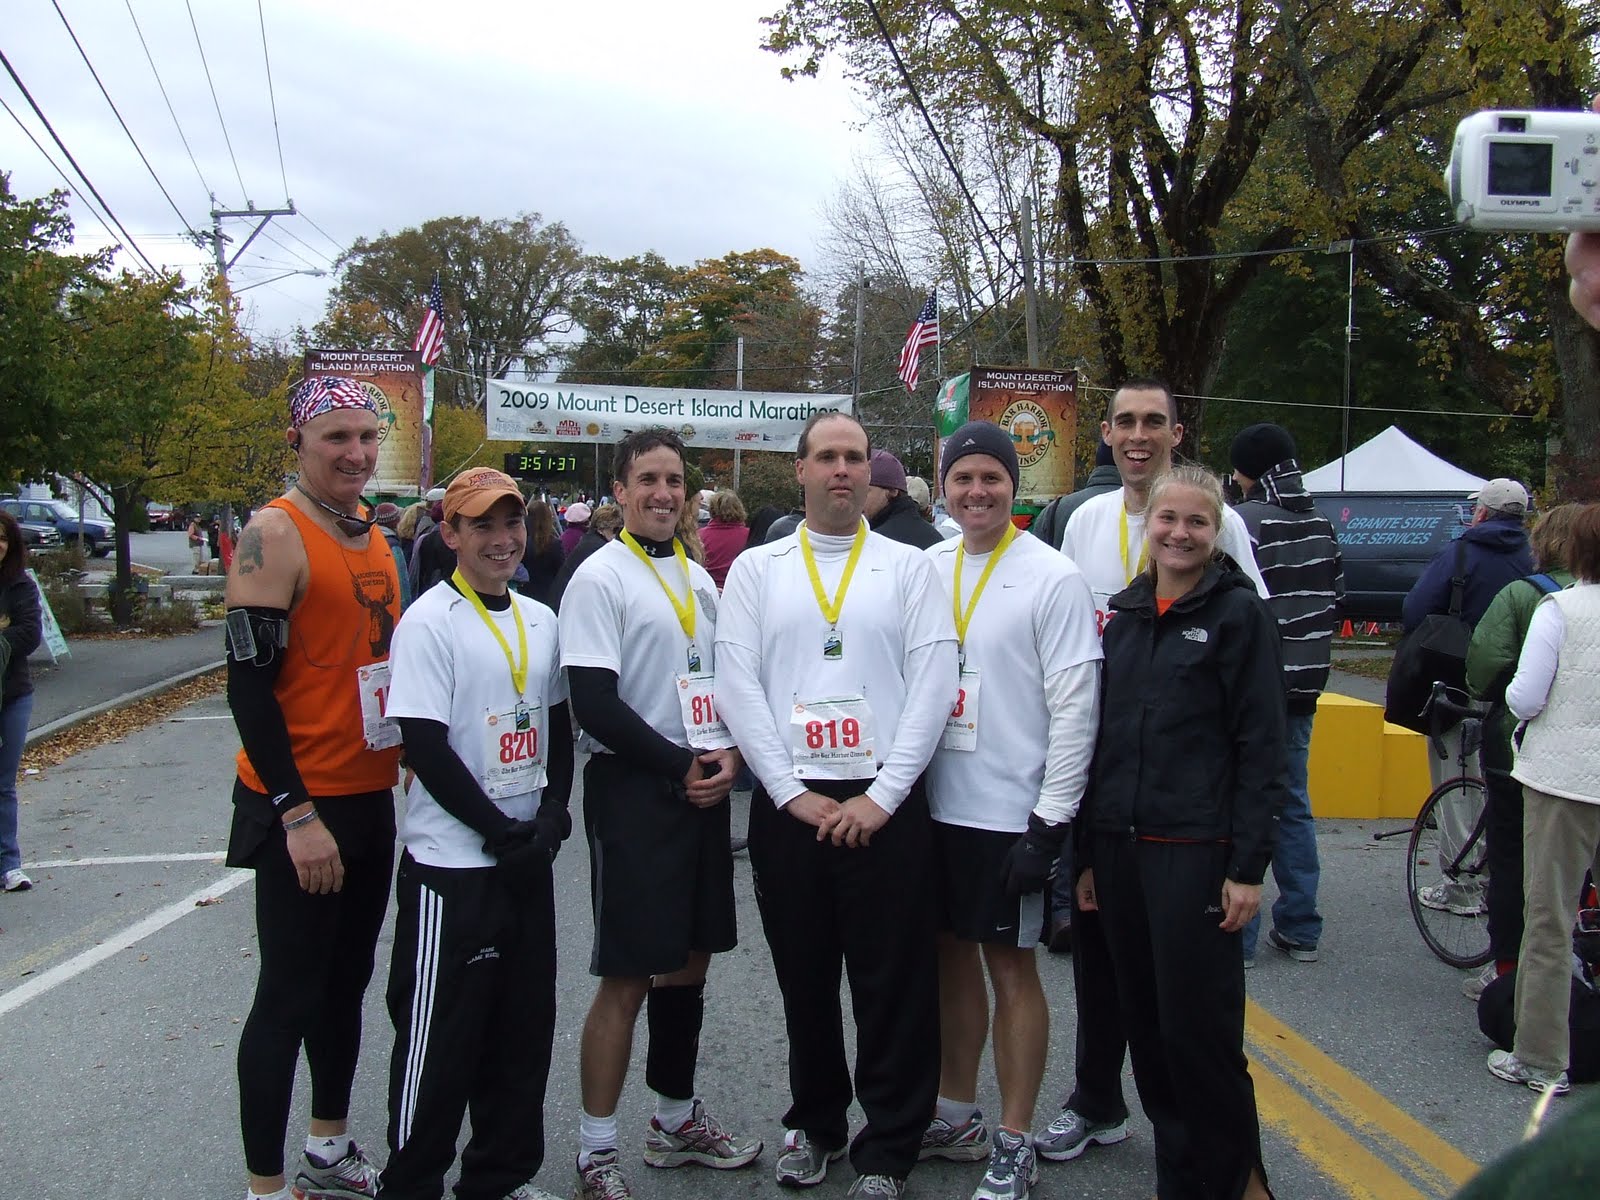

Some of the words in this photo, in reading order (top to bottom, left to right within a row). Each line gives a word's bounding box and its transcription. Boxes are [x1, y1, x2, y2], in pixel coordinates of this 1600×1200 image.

[320, 353, 359, 361] MOUNT
[311, 363, 352, 371] ISLAND
[354, 363, 415, 372] MARATHON
[987, 372, 1023, 381] MOUNT
[1025, 373, 1063, 382] DESERT
[978, 381, 1016, 389] ISLAND
[1018, 383, 1073, 392] MARATHON
[362, 385, 388, 411] ARBOR
[500, 390, 549, 409] 2009
[557, 392, 617, 412] Mount
[625, 395, 684, 415] Desert
[692, 398, 742, 417] Island
[1002, 408, 1016, 427] BAR
[1017, 403, 1048, 428] HARBOR
[1019, 454, 1036, 465] ING
[1347, 517, 1401, 529] GRANITE
[1401, 517, 1442, 528] STATE
[1367, 533, 1432, 545] SERVICES
[806, 718, 860, 749] 819
[500, 727, 538, 764] 820
